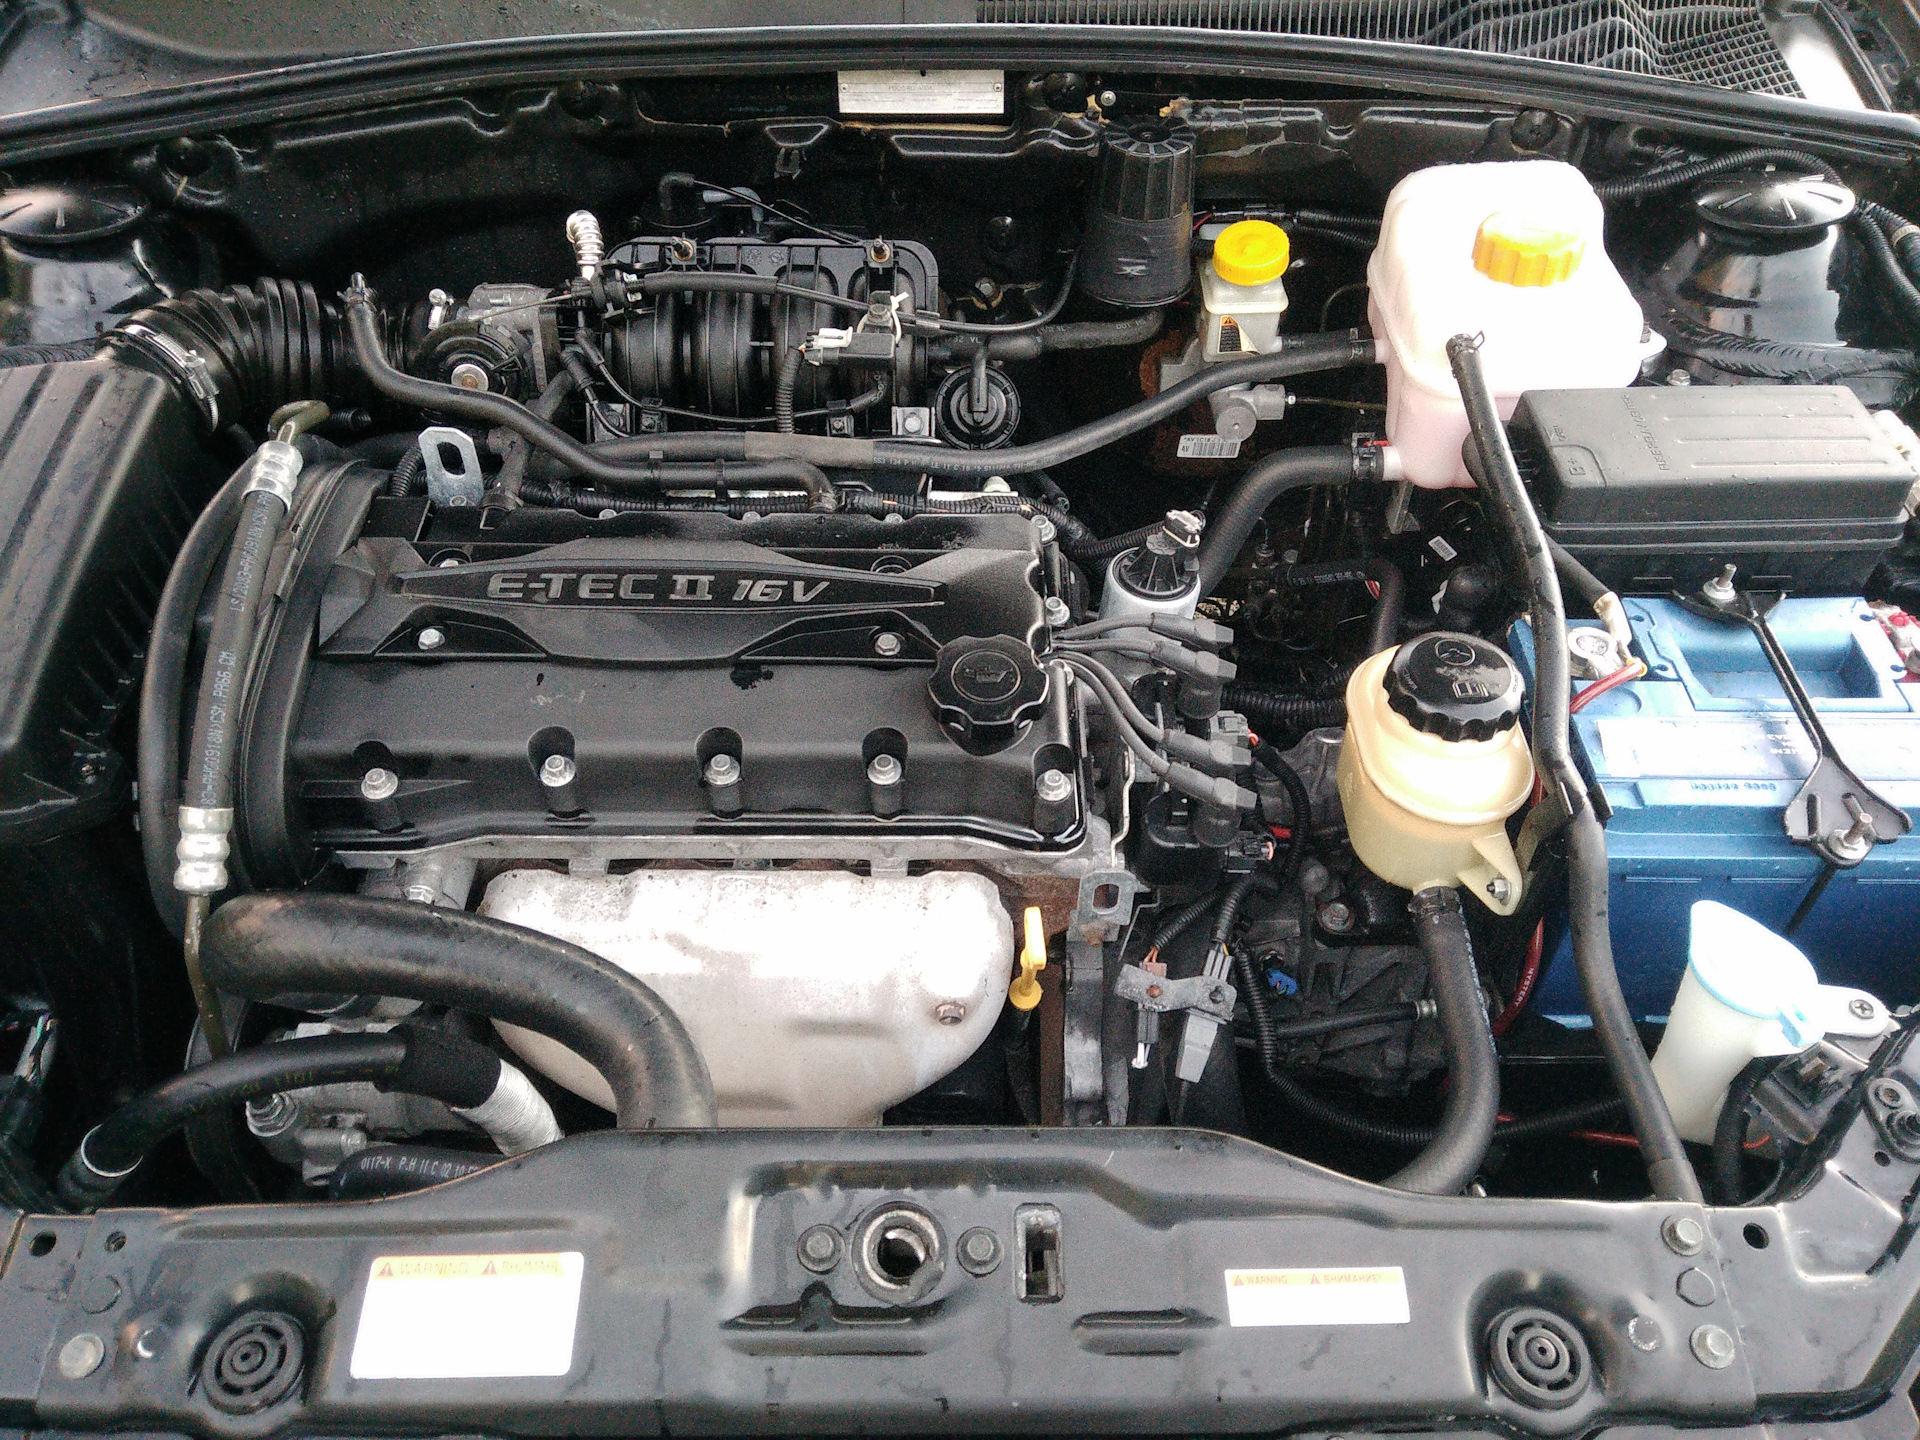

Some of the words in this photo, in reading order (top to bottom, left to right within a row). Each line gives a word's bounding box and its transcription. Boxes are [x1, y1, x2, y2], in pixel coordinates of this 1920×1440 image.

[487, 573, 658, 600] E-TEC
[669, 574, 715, 600] II
[732, 579, 830, 602] 16V
[1513, 967, 1534, 1007] MYSTERY
[1246, 1275, 1288, 1285] WARNING
